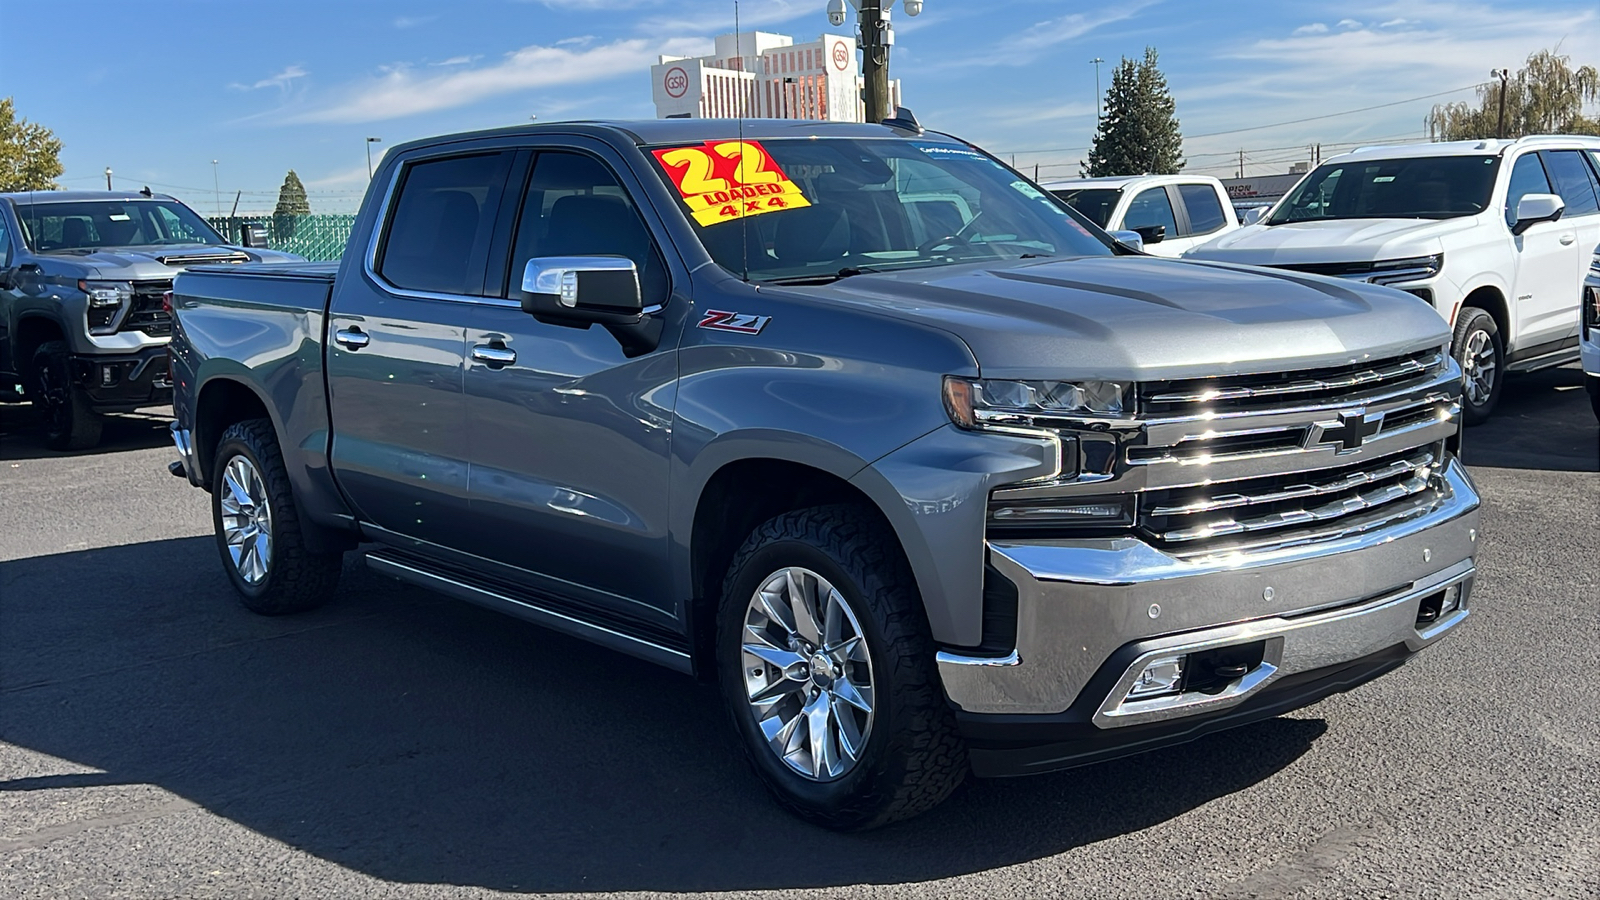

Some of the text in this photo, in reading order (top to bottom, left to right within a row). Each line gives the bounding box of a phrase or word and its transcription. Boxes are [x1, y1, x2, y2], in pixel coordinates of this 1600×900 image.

[834, 49, 848, 63] GSR
[667, 75, 686, 90] GSR
[661, 141, 783, 195] 22
[702, 182, 786, 207] LOADED
[695, 308, 773, 336] Z71
